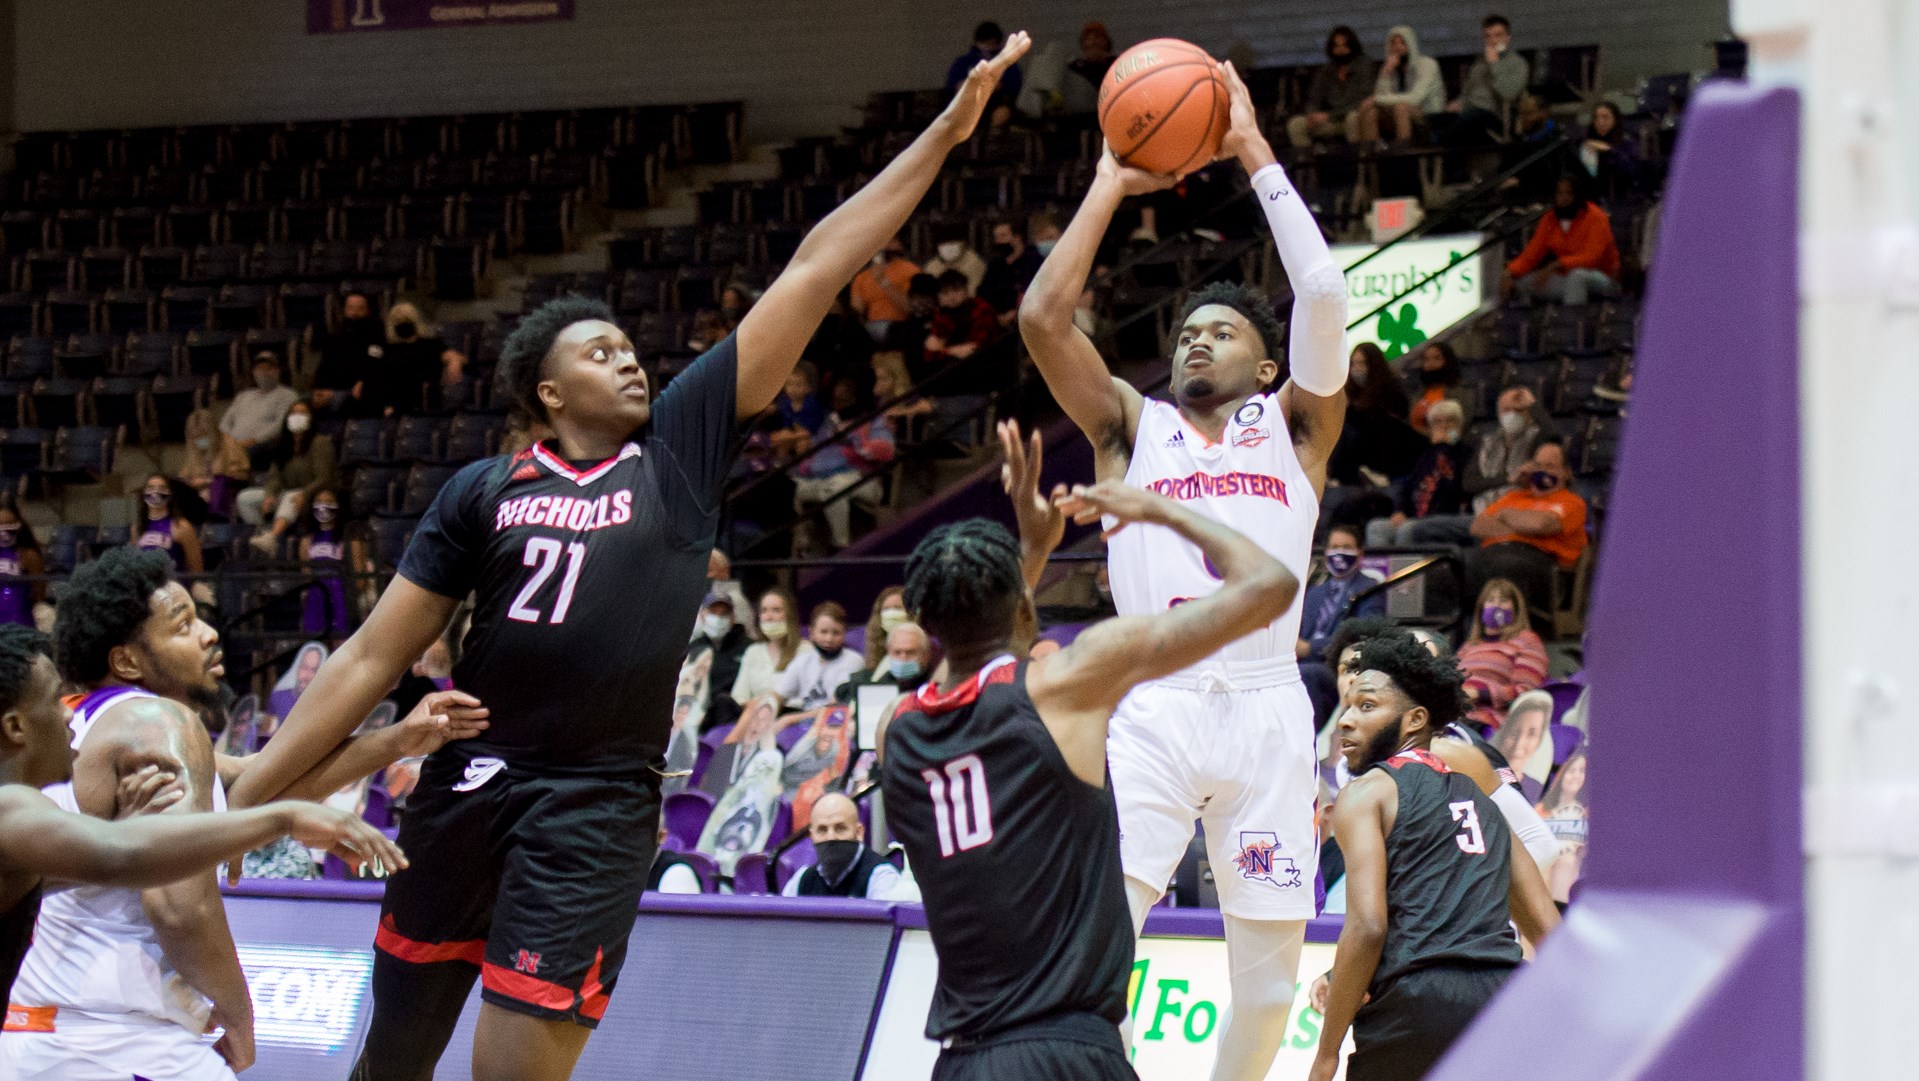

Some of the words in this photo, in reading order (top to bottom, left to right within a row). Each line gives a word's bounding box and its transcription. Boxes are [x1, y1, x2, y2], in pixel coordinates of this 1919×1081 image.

[1347, 250, 1474, 304] urphy's
[496, 489, 632, 531] NICHOLLS
[508, 536, 585, 625] 21
[921, 753, 993, 857] 10
[1448, 800, 1486, 853] 3
[1248, 847, 1274, 875] N
[515, 949, 542, 973] N
